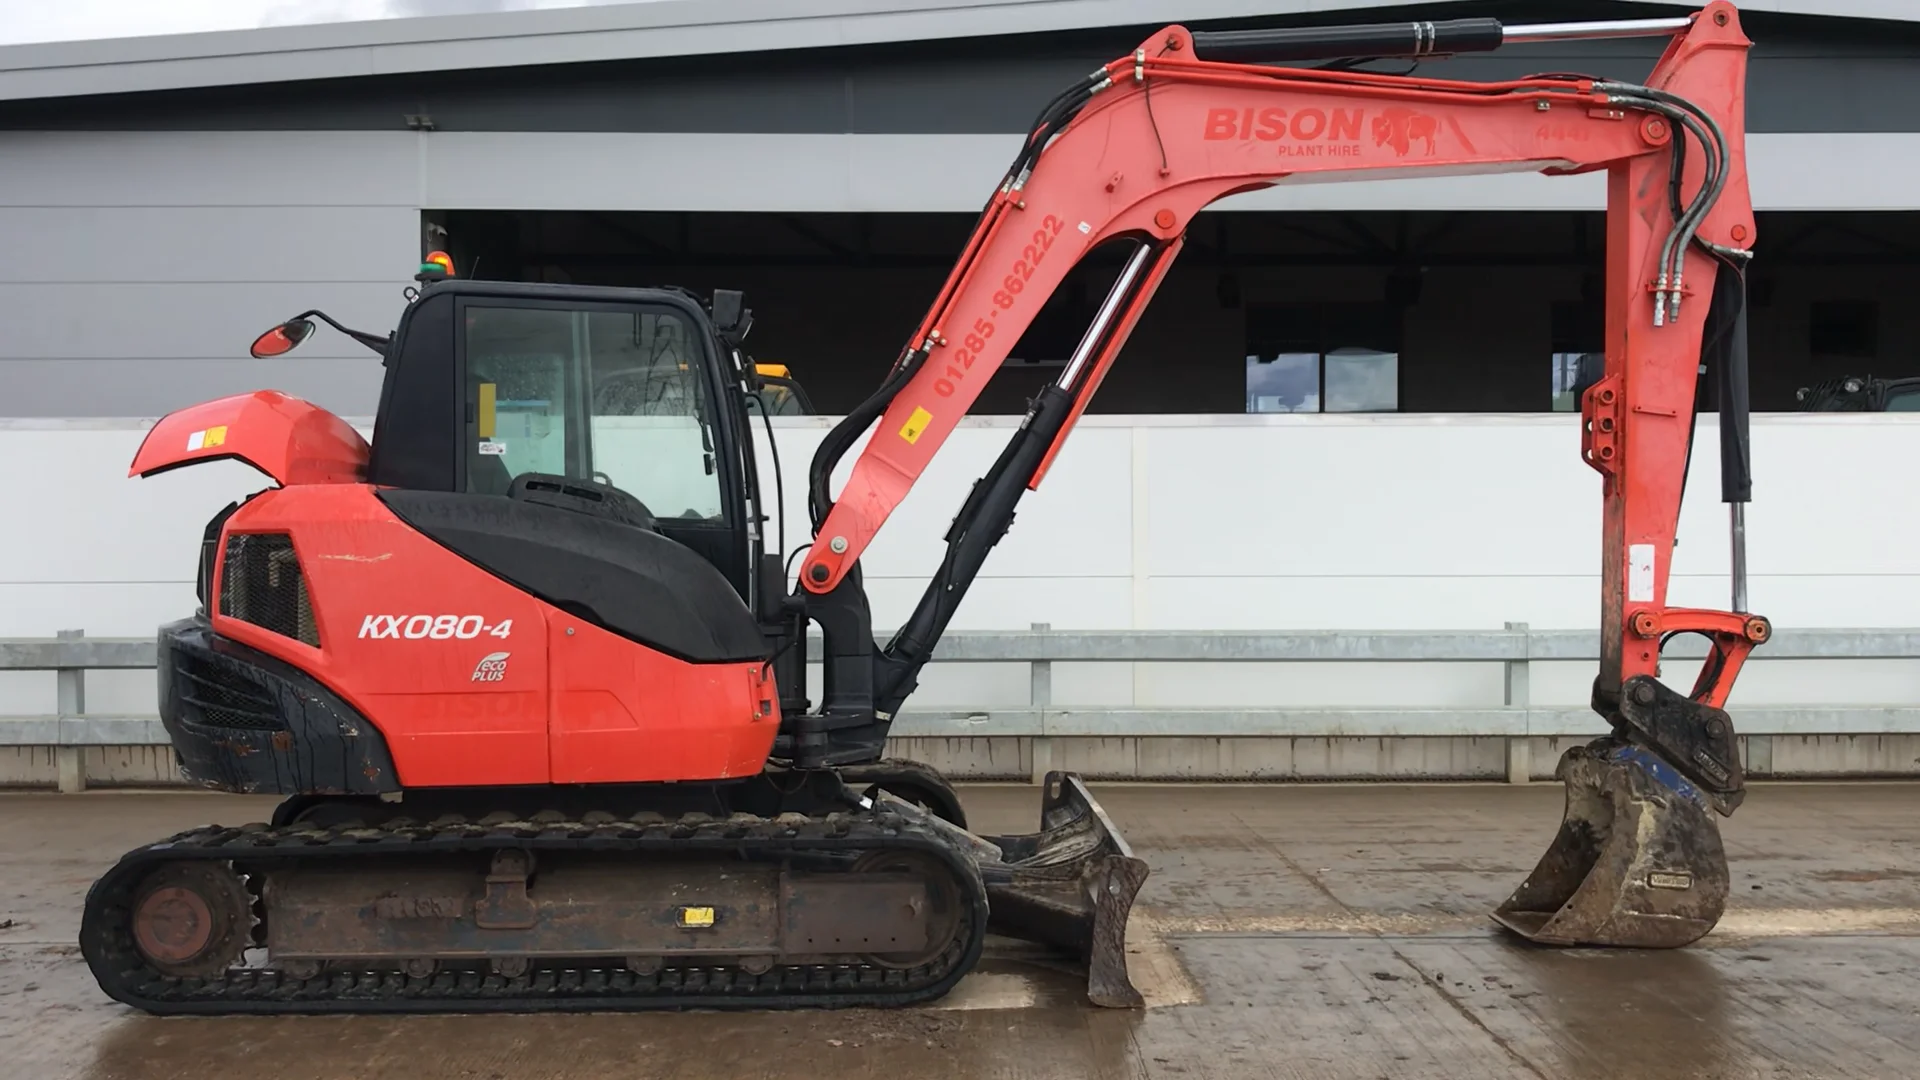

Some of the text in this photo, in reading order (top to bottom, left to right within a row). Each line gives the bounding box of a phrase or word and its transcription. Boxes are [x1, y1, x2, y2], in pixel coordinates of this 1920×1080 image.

[1203, 107, 1365, 142] BISON
[1278, 144, 1361, 157] PLANT HIRE
[933, 214, 1065, 398] 01285-862222
[358, 615, 513, 640] KX080-4
[481, 660, 507, 672] eco
[471, 670, 505, 682] PLUS
